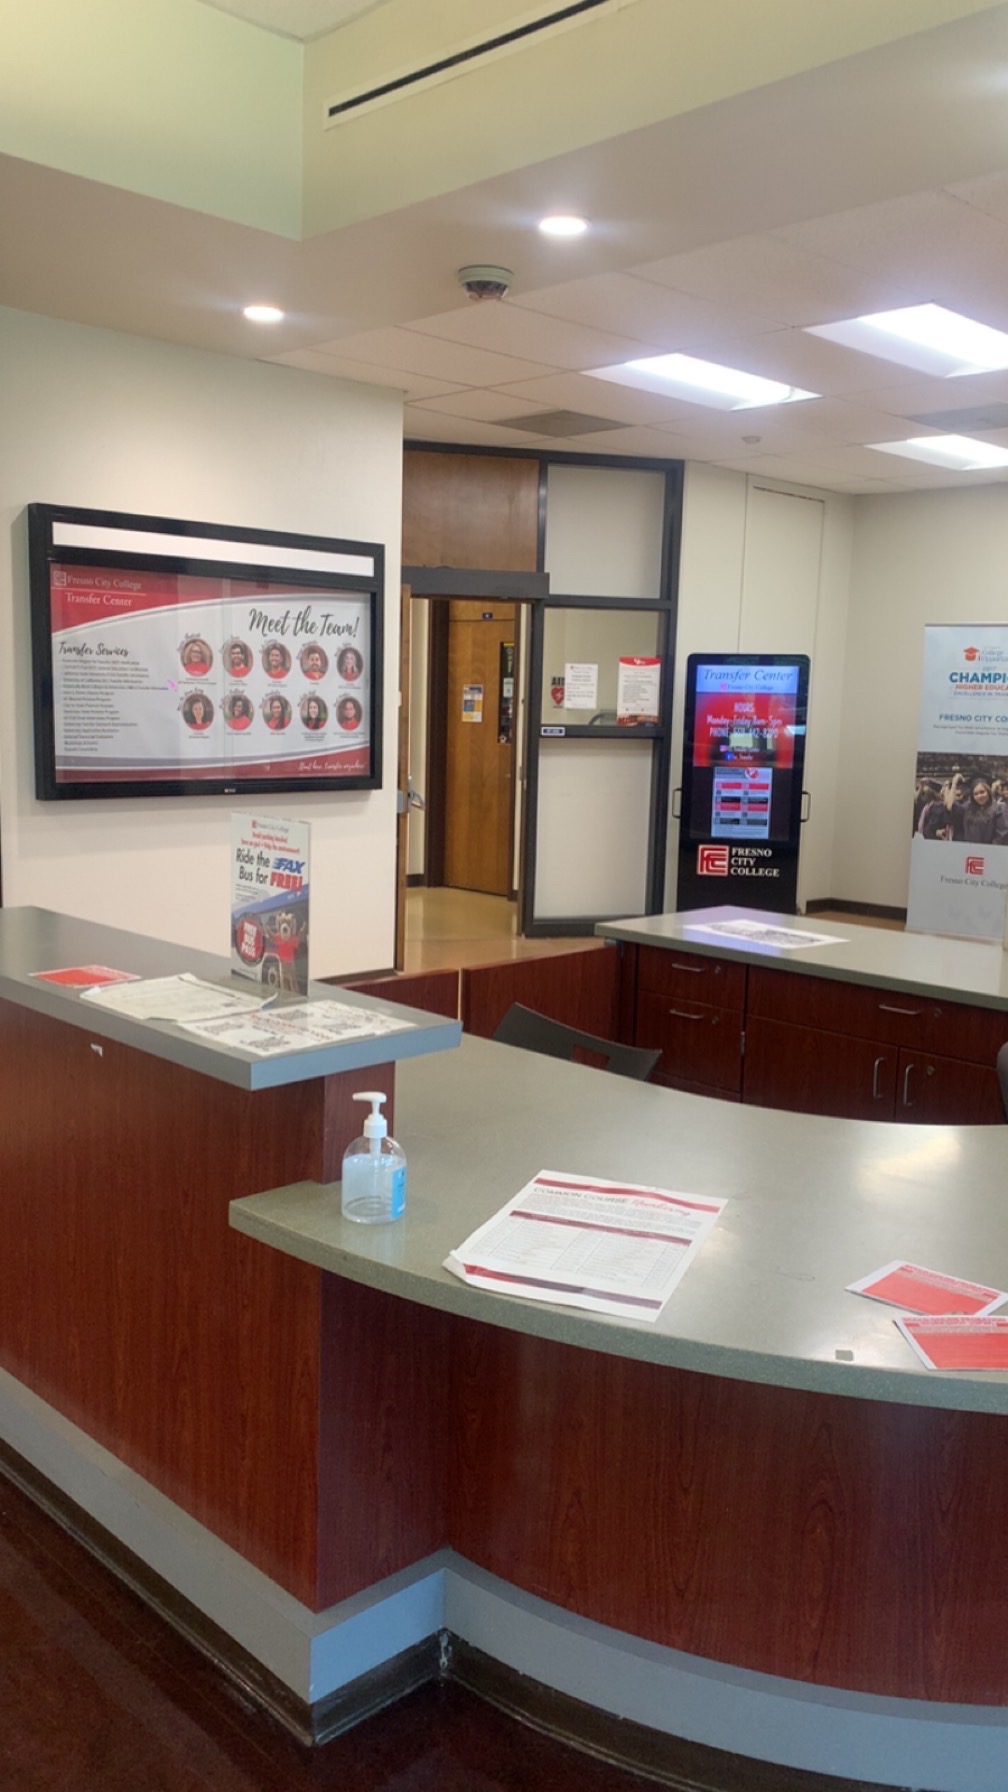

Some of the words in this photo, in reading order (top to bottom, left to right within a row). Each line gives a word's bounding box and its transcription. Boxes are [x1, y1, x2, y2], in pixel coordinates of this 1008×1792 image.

[67, 576, 94, 585] Fresno
[95, 576, 111, 588] City
[113, 578, 141, 591] College
[65, 592, 101, 605] Transfer
[103, 594, 132, 607] Center
[249, 608, 290, 637] Meet
[292, 605, 318, 637] the
[320, 613, 360, 638] Team!
[58, 641, 94, 657] Transfer
[96, 642, 129, 658] Services
[704, 668, 751, 682] Transfer
[754, 668, 793, 681] Center
[949, 671, 1008, 684] CHAMPI
[939, 714, 972, 723] FRESNO
[973, 715, 992, 723] CITY
[731, 847, 772, 858] FRESNO
[235, 848, 254, 865] Ride
[256, 850, 270, 868] the
[272, 857, 305, 874] FAX
[730, 857, 756, 867] CITY
[239, 865, 254, 882] Bus
[255, 867, 269, 885] for
[270, 872, 303, 895] FREE!
[730, 867, 780, 878] COLLEGE
[533, 1187, 582, 1198] COMMON
[583, 1193, 628, 1205] COURSE
